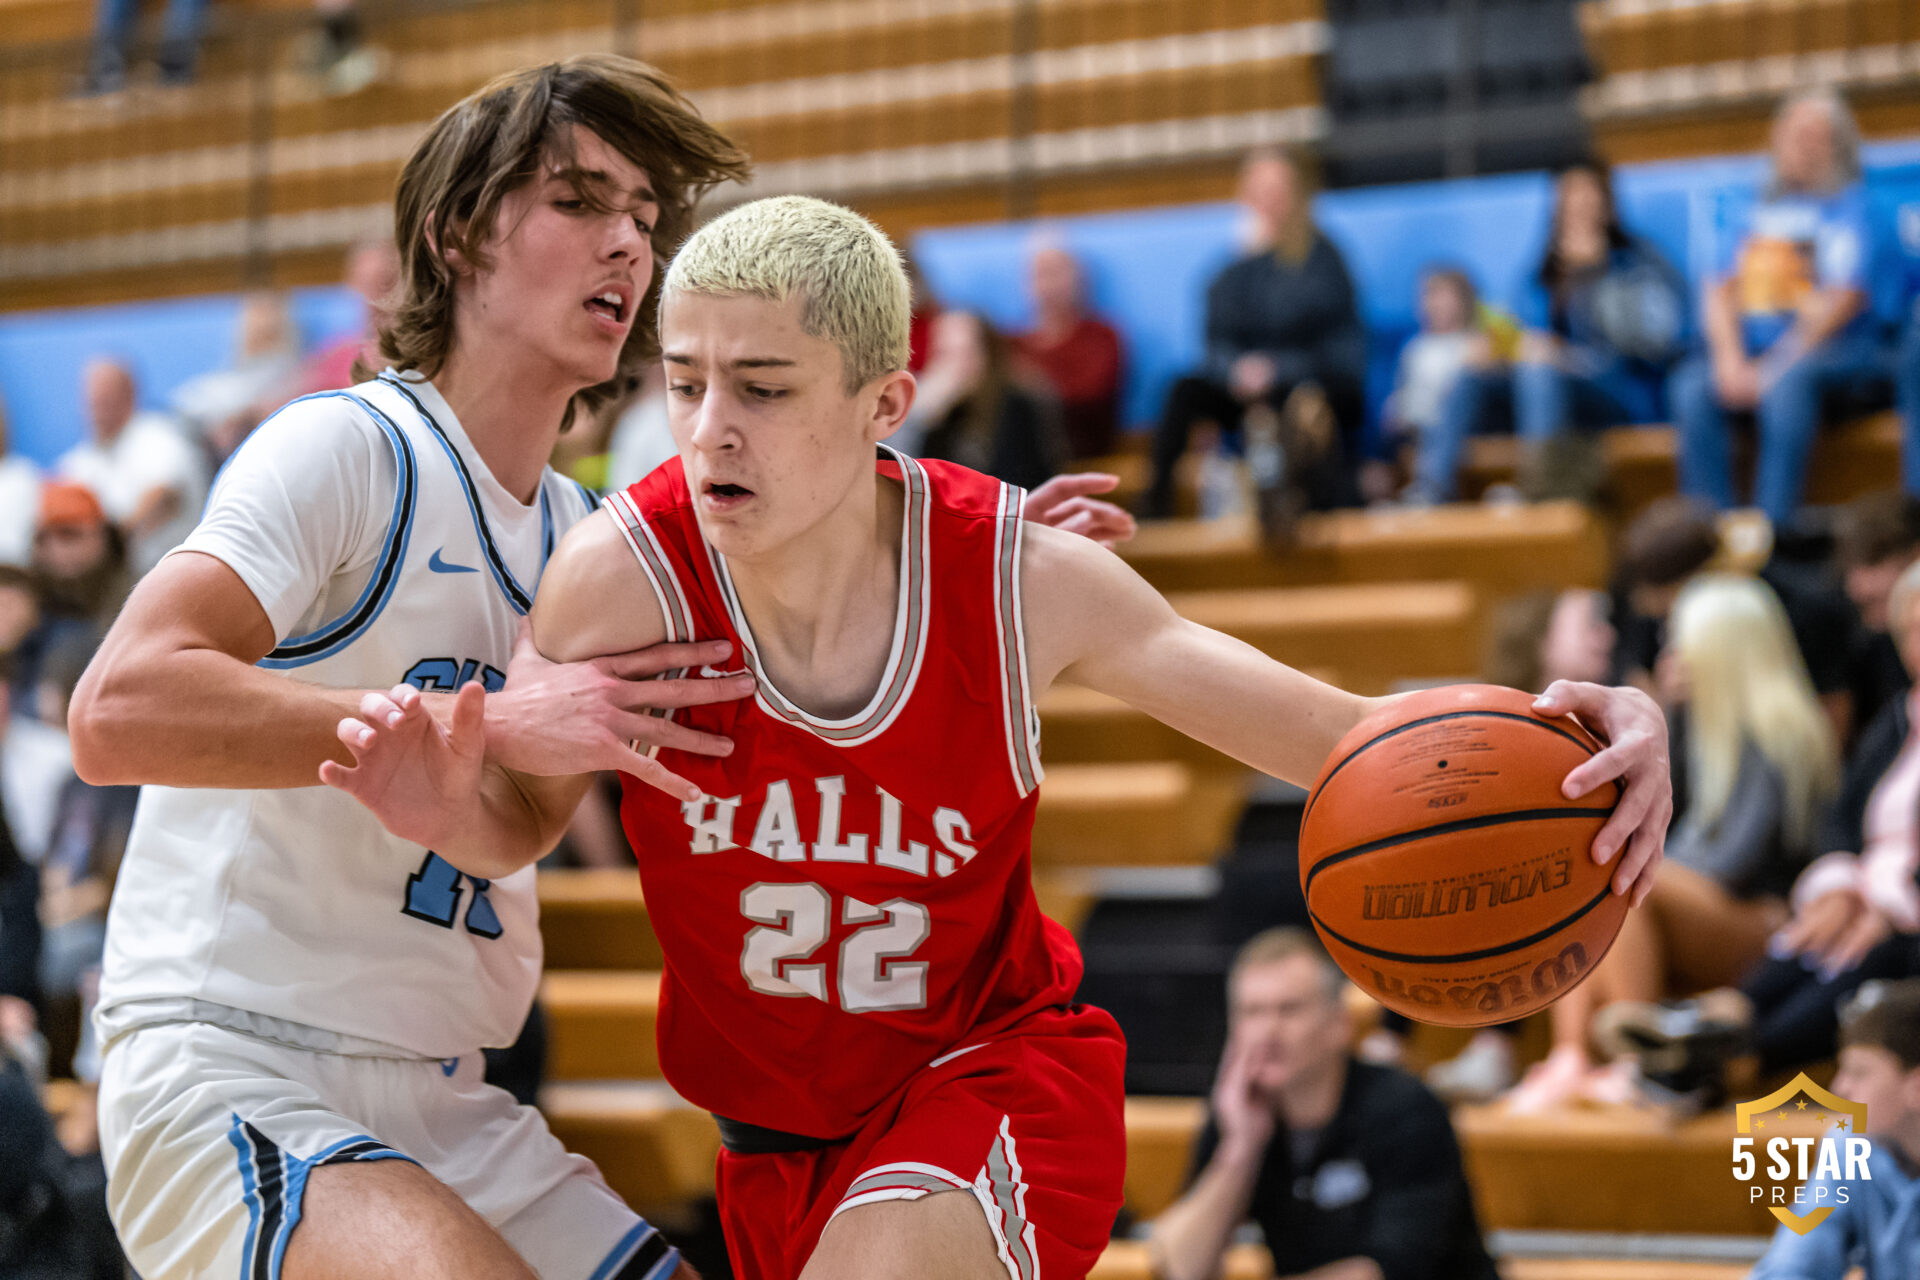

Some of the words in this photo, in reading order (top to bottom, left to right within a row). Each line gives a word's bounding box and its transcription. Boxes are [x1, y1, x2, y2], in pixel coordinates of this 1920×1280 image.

[680, 774, 979, 878] HALLS
[1362, 857, 1573, 921] EVOLUTION
[739, 881, 931, 1014] 22
[1368, 941, 1590, 1014] Wilson
